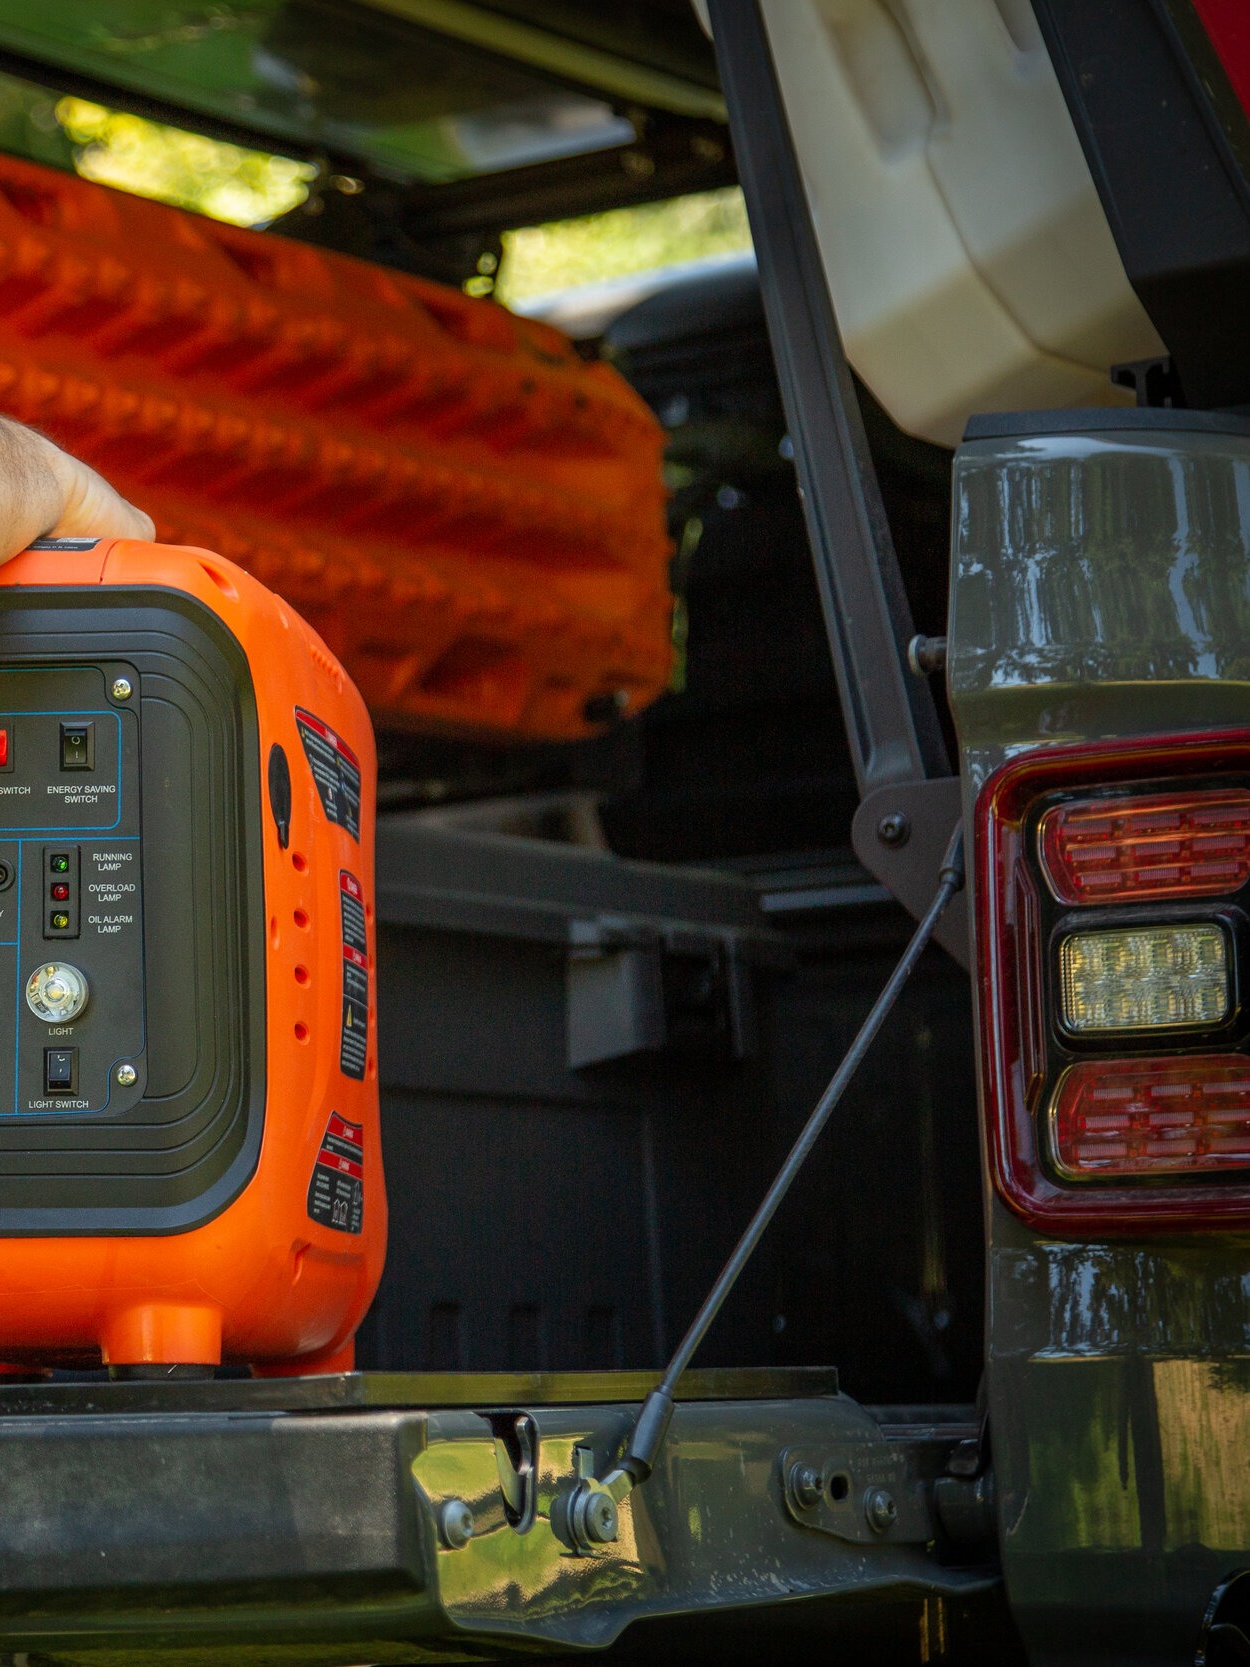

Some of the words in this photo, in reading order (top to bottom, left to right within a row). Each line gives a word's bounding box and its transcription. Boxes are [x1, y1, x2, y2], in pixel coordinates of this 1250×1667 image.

[47, 785, 83, 794] ENERGY
[84, 784, 116, 794] SAVING
[64, 795, 98, 804] SWITCH
[92, 852, 133, 862] RUNNING
[97, 862, 122, 871] LAMP
[88, 883, 136, 893] OVERLOAD
[98, 893, 122, 902] LAMP
[87, 915, 103, 924] OIL
[102, 915, 133, 924] ALARM
[97, 925, 122, 934] LAMP
[48, 1027, 73, 1036] LIGHT
[28, 1100, 53, 1109] LIGHT
[55, 1100, 89, 1109] SWITCH
